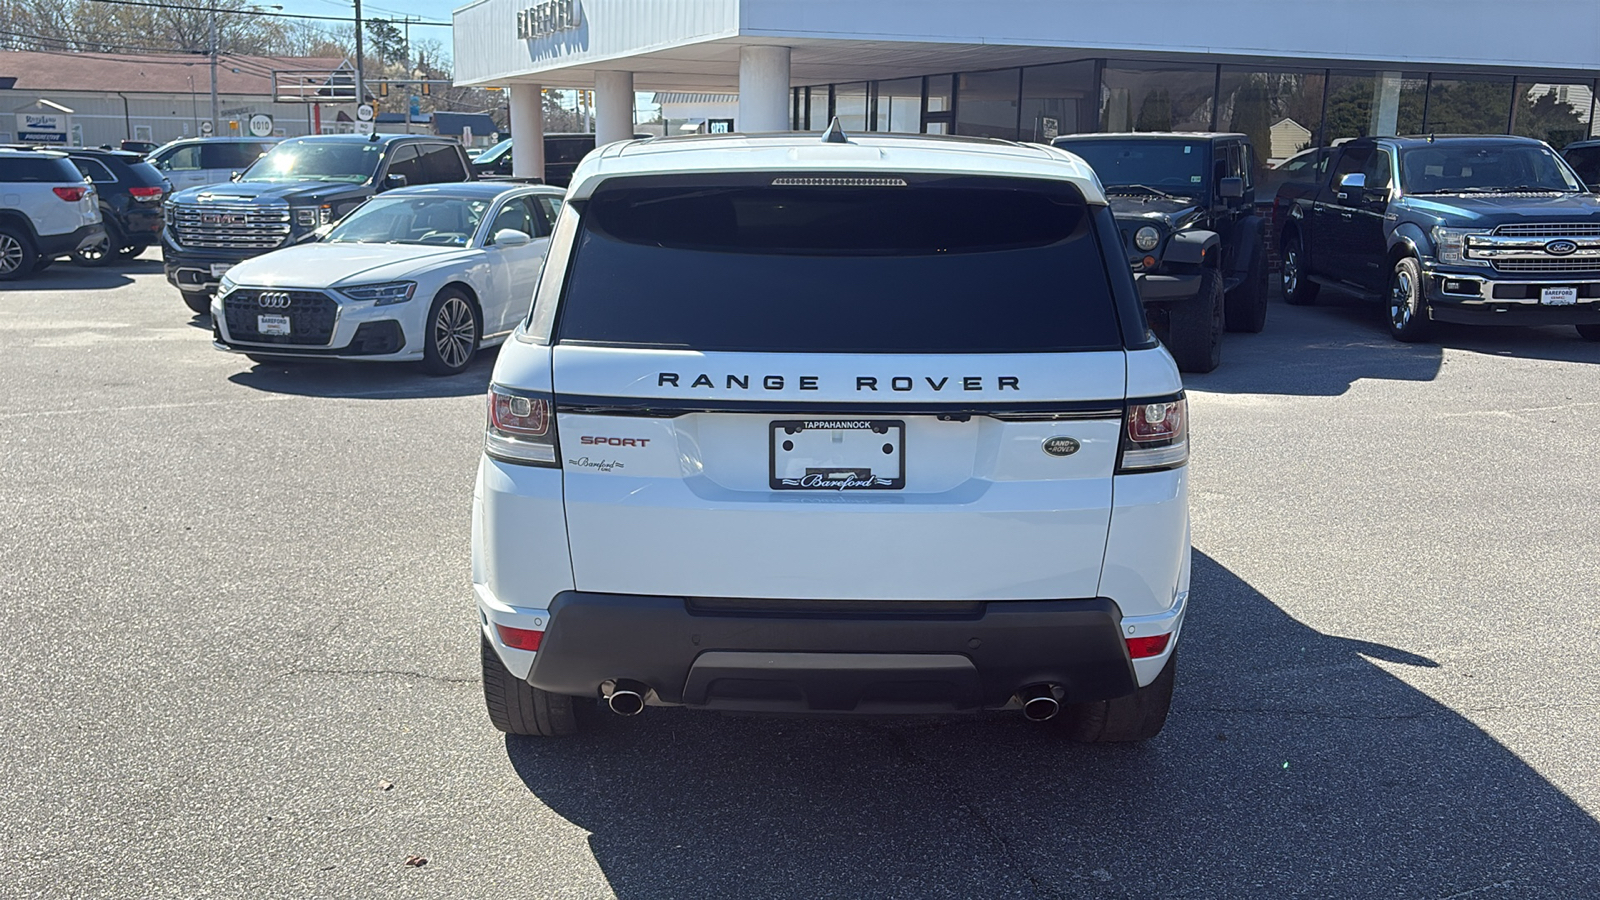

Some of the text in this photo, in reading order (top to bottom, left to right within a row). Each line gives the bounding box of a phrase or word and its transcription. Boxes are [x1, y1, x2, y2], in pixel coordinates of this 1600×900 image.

[252, 121, 270, 130] 1010
[202, 214, 245, 223] GMC
[1553, 243, 1570, 251] Ford
[658, 372, 1020, 391] RANGE ROVER
[804, 421, 871, 429] TAPPAHANNOCK
[580, 435, 651, 448] SPORT
[577, 456, 616, 471] Bareford
[800, 474, 875, 491] Bareford
